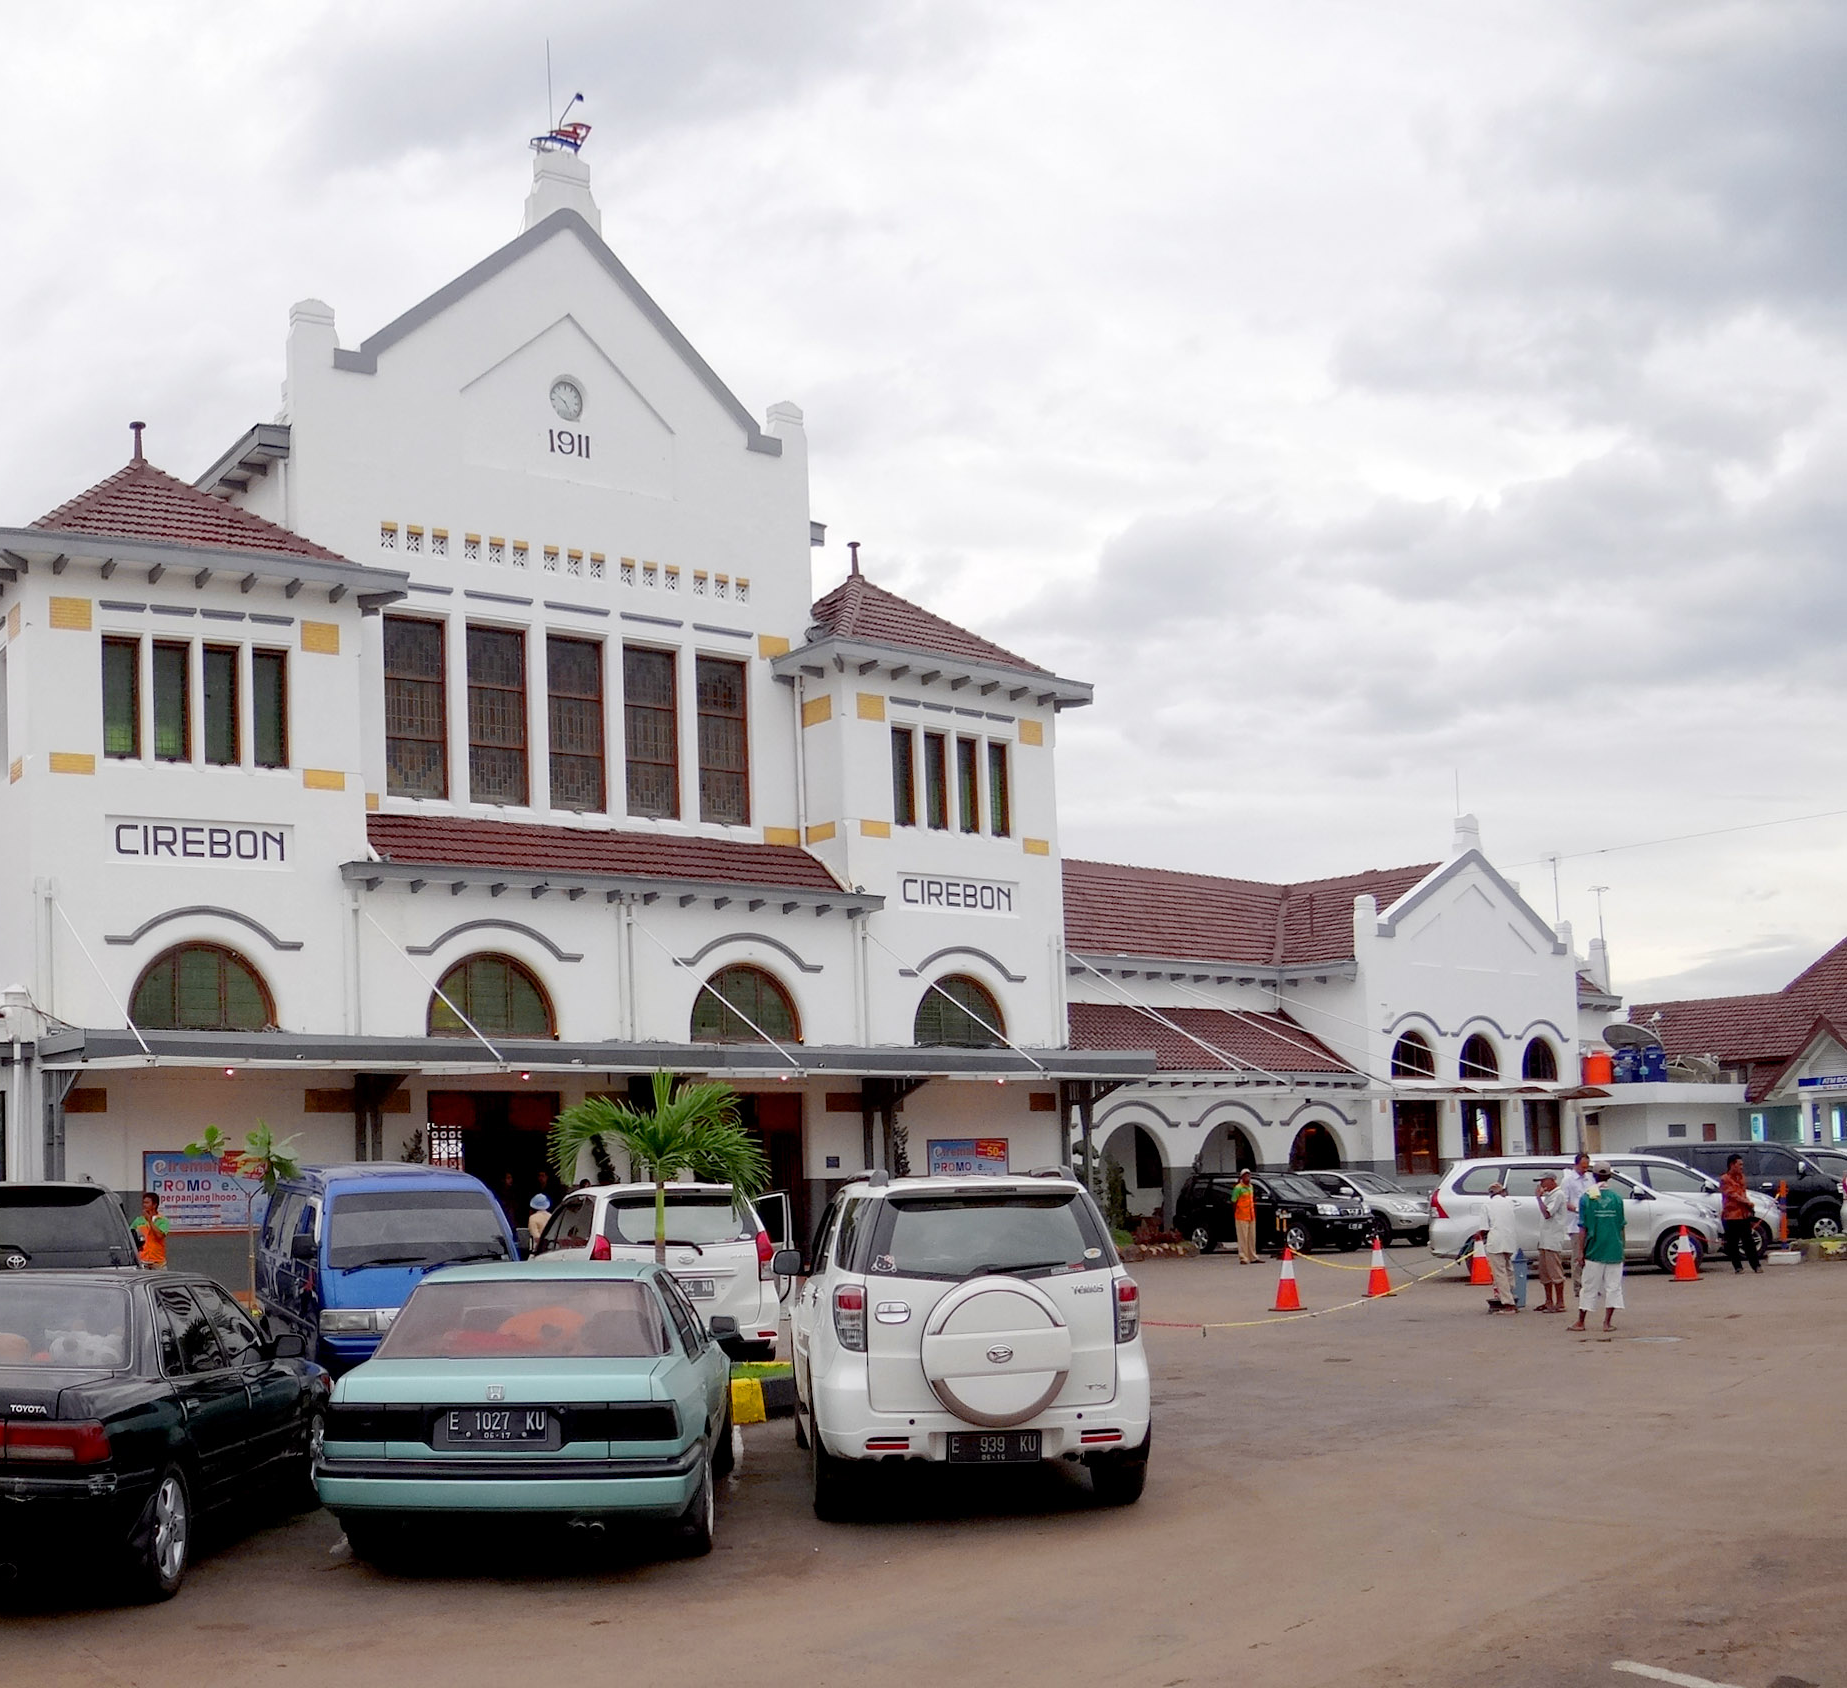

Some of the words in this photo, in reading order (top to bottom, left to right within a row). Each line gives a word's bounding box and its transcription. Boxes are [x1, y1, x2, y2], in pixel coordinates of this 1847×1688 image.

[549, 429, 590, 459] 1911
[115, 824, 285, 862] CIREBON
[903, 878, 1012, 911] CIREBON
[933, 1162, 972, 1172] PROMO
[153, 1180, 212, 1192] PROMO
[702, 1281, 713, 1292] NA
[10, 1404, 47, 1414] TOYOTA
[449, 1411, 459, 1430] E
[475, 1411, 510, 1430] 1027
[526, 1411, 545, 1430] KU
[951, 1437, 960, 1453] E
[980, 1436, 1005, 1453] 939
[1020, 1435, 1037, 1452] KU
